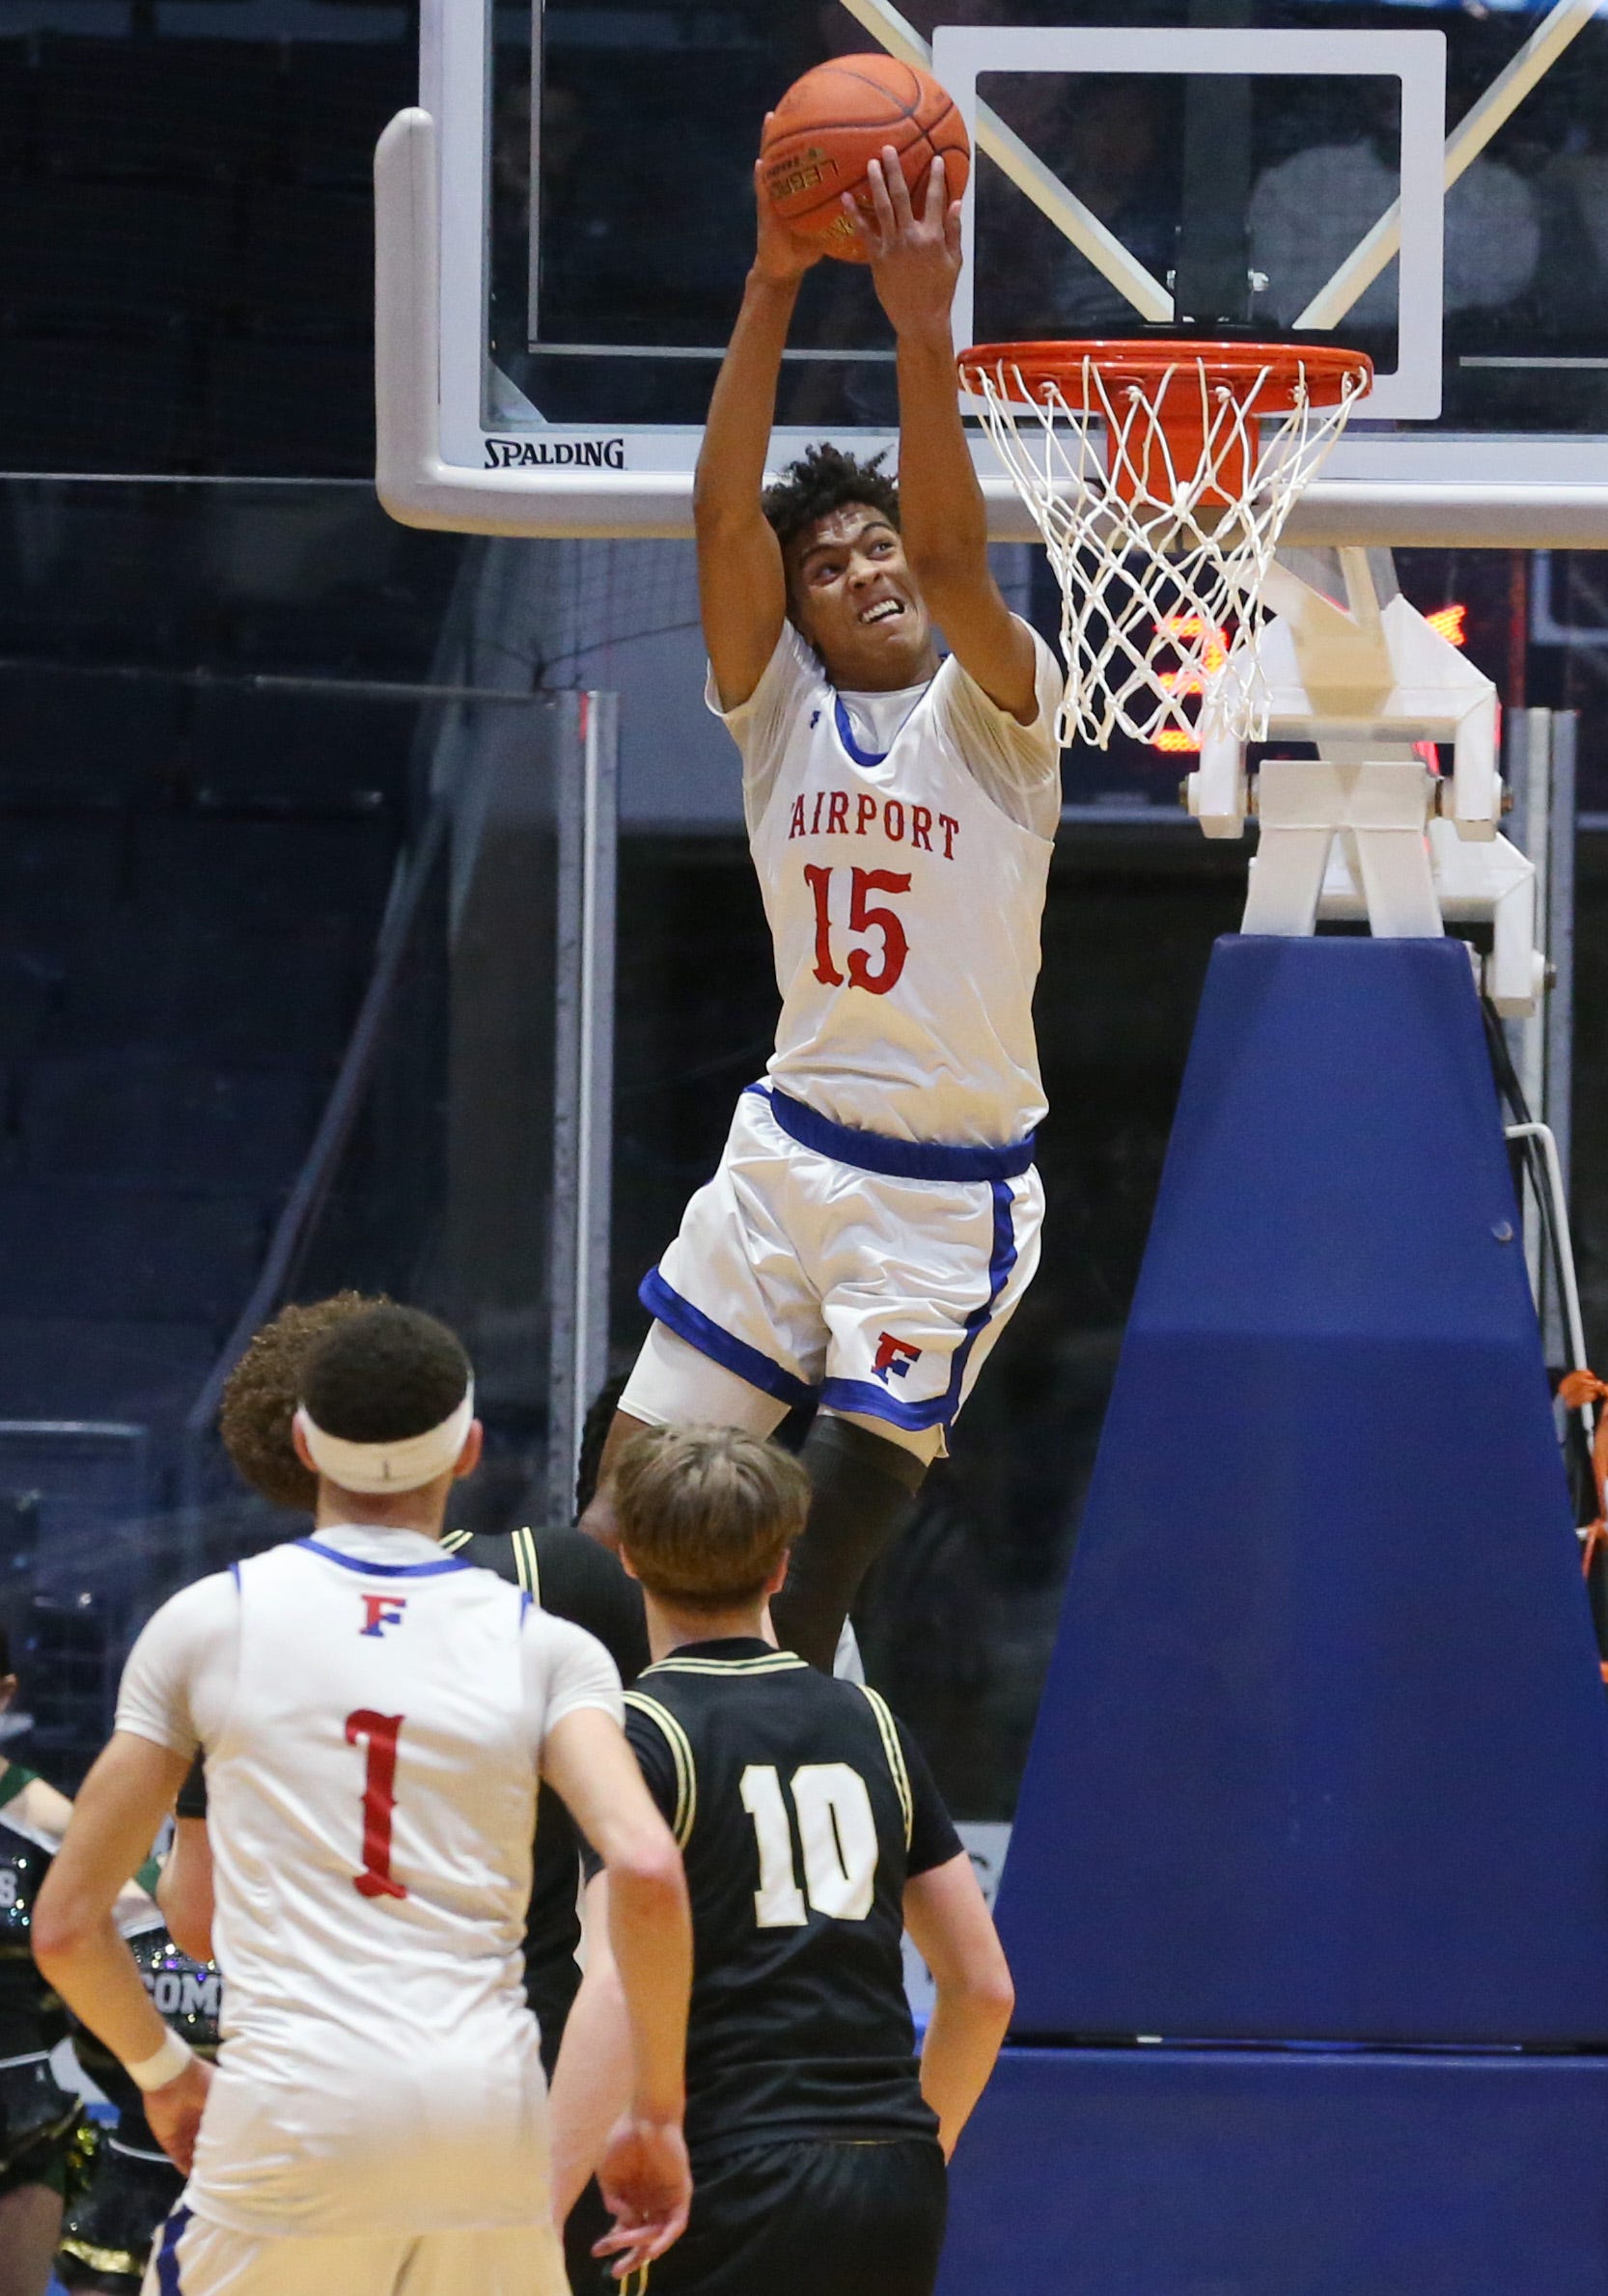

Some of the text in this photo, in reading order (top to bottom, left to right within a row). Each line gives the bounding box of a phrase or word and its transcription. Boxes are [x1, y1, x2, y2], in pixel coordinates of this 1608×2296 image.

[485, 438, 624, 469] SPALDING
[789, 790, 959, 860] AIRPORT
[804, 864, 911, 995] 15
[871, 1331, 923, 1385] F
[359, 1594, 406, 1638] F
[345, 1708, 408, 1899] 1
[739, 1762, 879, 1928] 10
